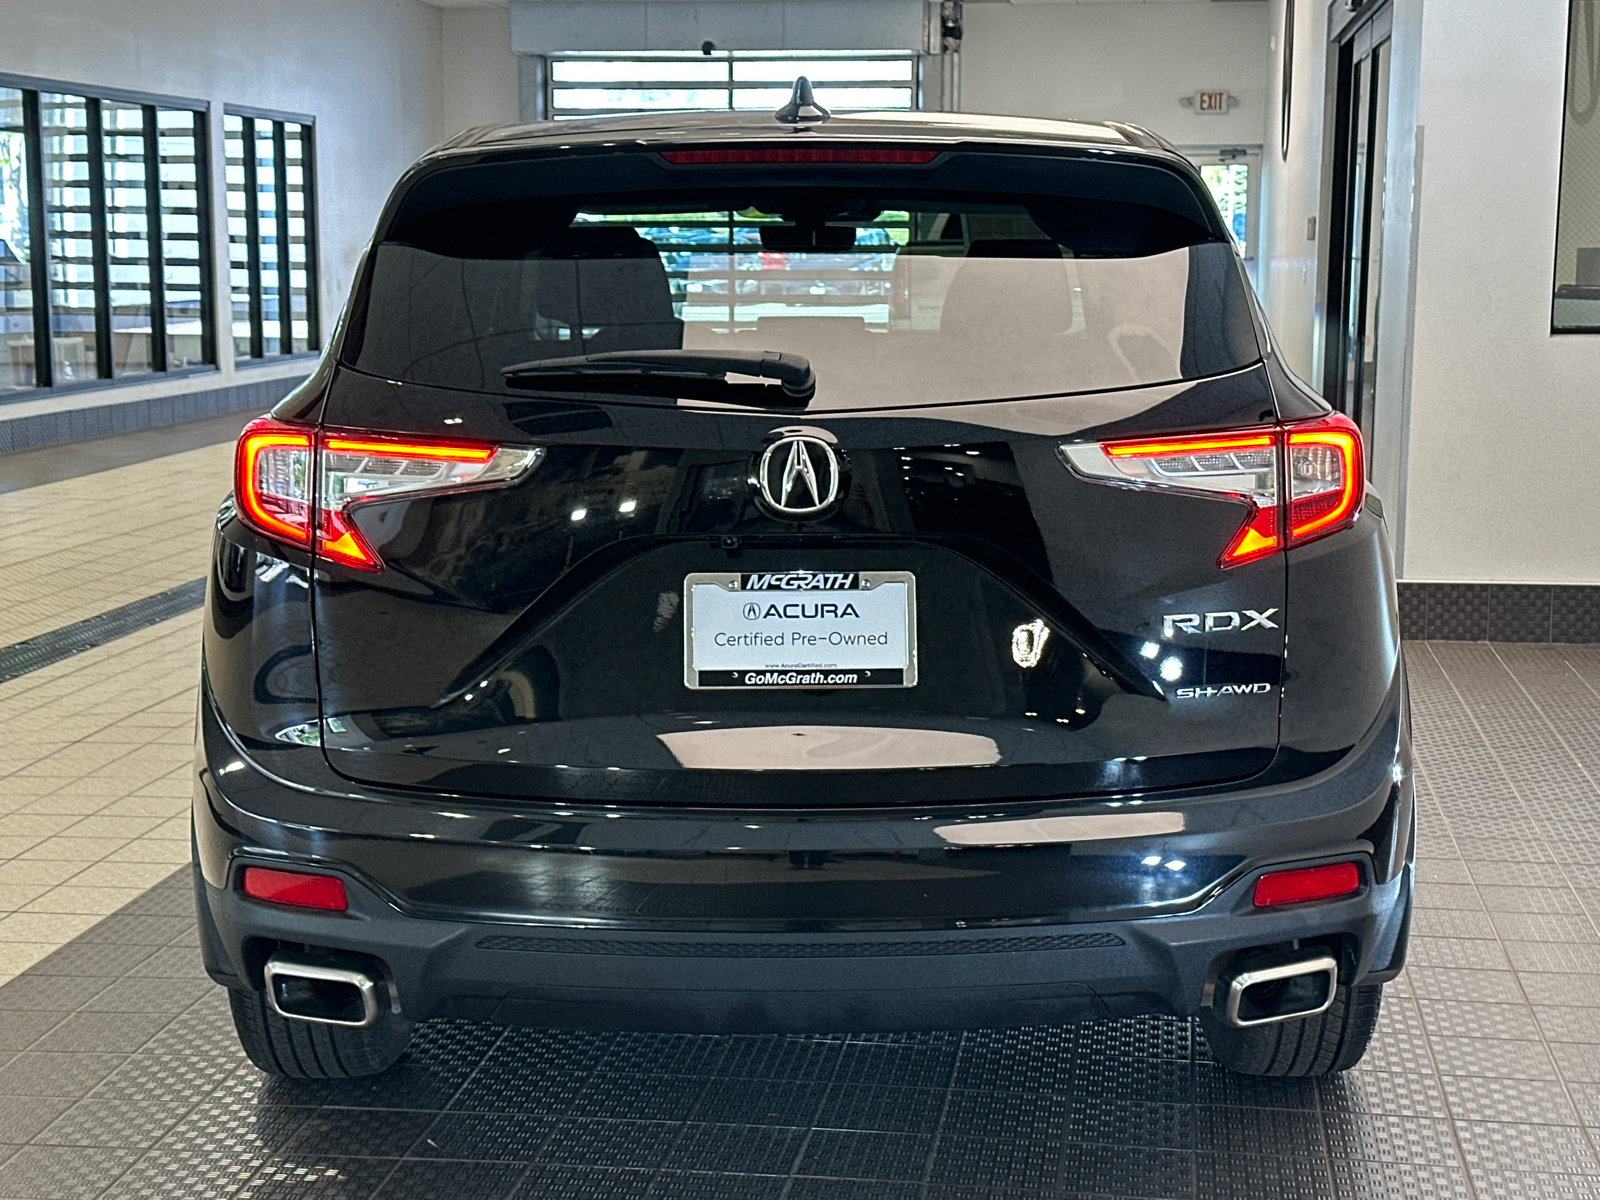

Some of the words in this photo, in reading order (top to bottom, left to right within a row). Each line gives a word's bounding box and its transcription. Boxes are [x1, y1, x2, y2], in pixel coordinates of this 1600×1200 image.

[1200, 92, 1224, 110] EXIT
[762, 603, 860, 619] ACURA
[1163, 608, 1279, 635] RDX
[714, 632, 784, 646] Certified
[791, 631, 888, 646] Pre-Owned
[744, 671, 858, 685] GoMcGrath.com
